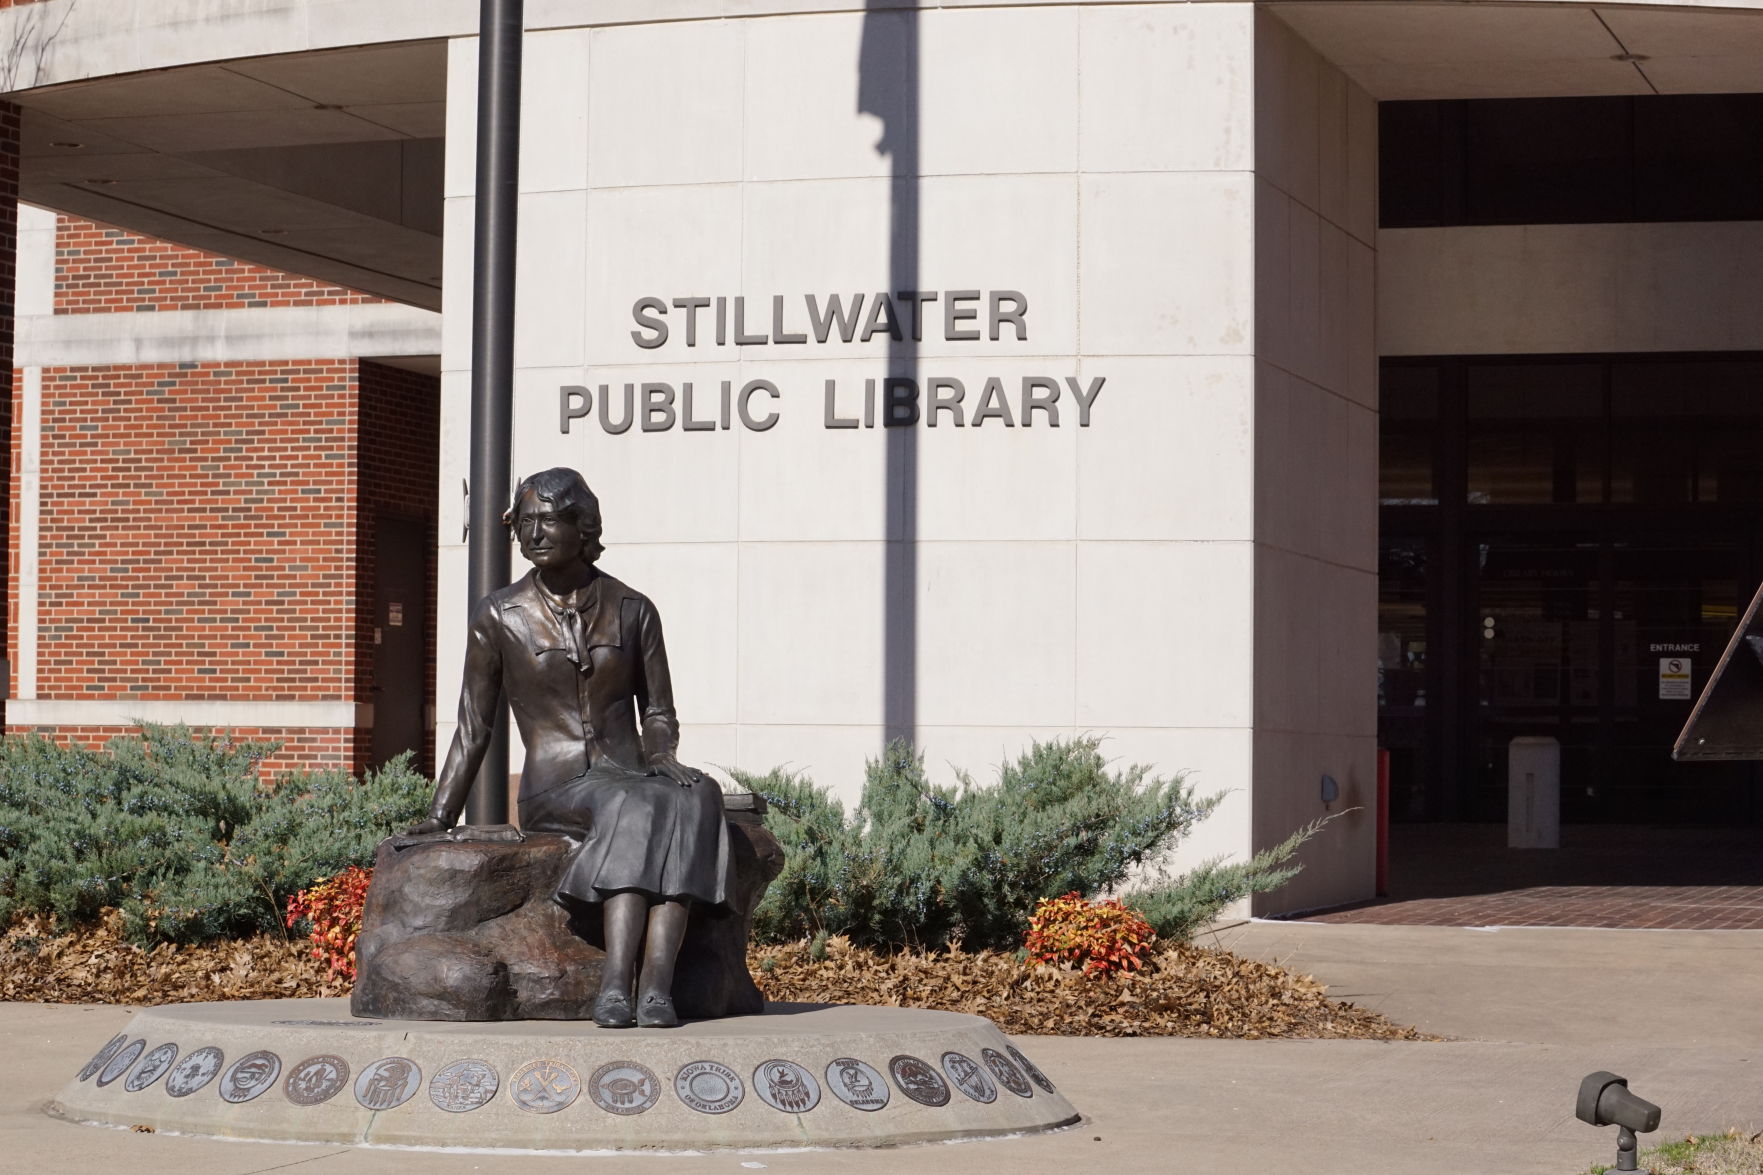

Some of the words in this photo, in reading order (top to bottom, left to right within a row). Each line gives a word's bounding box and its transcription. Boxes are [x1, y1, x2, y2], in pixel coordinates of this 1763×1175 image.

[630, 289, 1028, 350] STILLWATER
[559, 379, 781, 435] PUBLIC
[823, 376, 1107, 429] LIBRARY
[1650, 643, 1701, 652] ENTRANCE
[679, 1064, 707, 1082] KIOWA
[708, 1064, 737, 1083] TRIBE
[684, 1094, 696, 1103] OF
[695, 1095, 739, 1111] OKLAHOMA
[849, 1098, 885, 1106] OKLAHOMA
